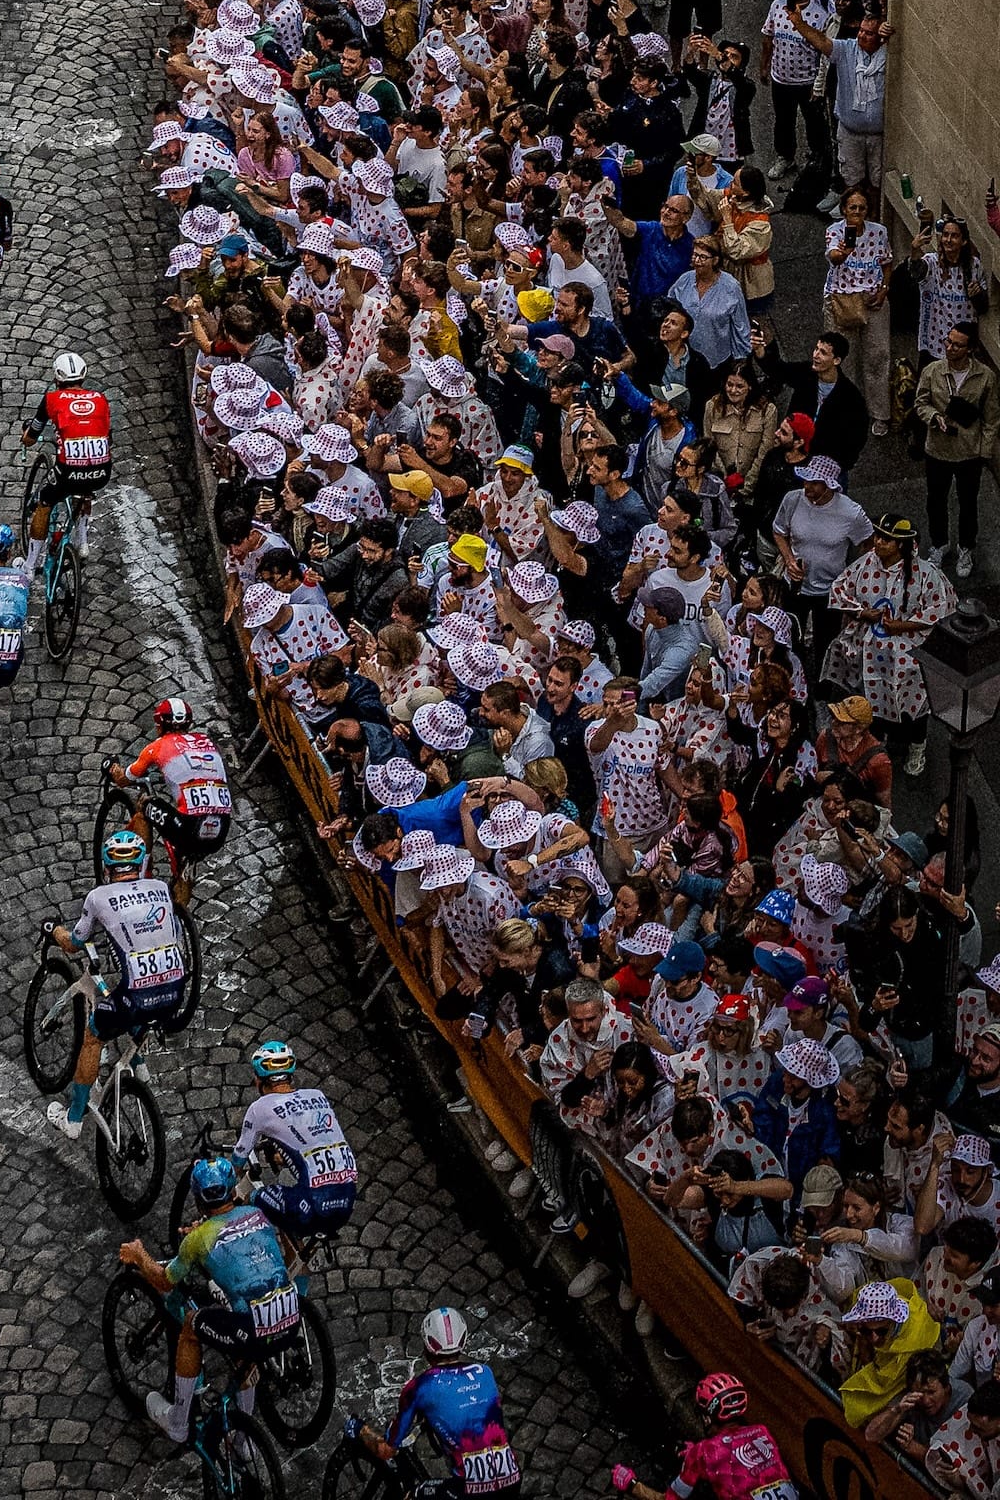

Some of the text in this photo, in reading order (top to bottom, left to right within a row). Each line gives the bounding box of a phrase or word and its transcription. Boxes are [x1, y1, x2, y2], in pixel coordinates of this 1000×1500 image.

[66, 440, 88, 458] 131
[68, 469, 107, 480] ARKEA
[190, 788, 230, 807] 65 65
[108, 889, 169, 907] BAHRAIN
[136, 947, 181, 977] 58 58
[134, 975, 161, 988] VELUX
[792, 985, 806, 995] EF
[312, 1149, 336, 1175] 56
[339, 1145, 354, 1170] 56
[313, 1171, 340, 1186] VELUX
[464, 1452, 495, 1483] 208
[465, 1481, 497, 1495] VELUX
